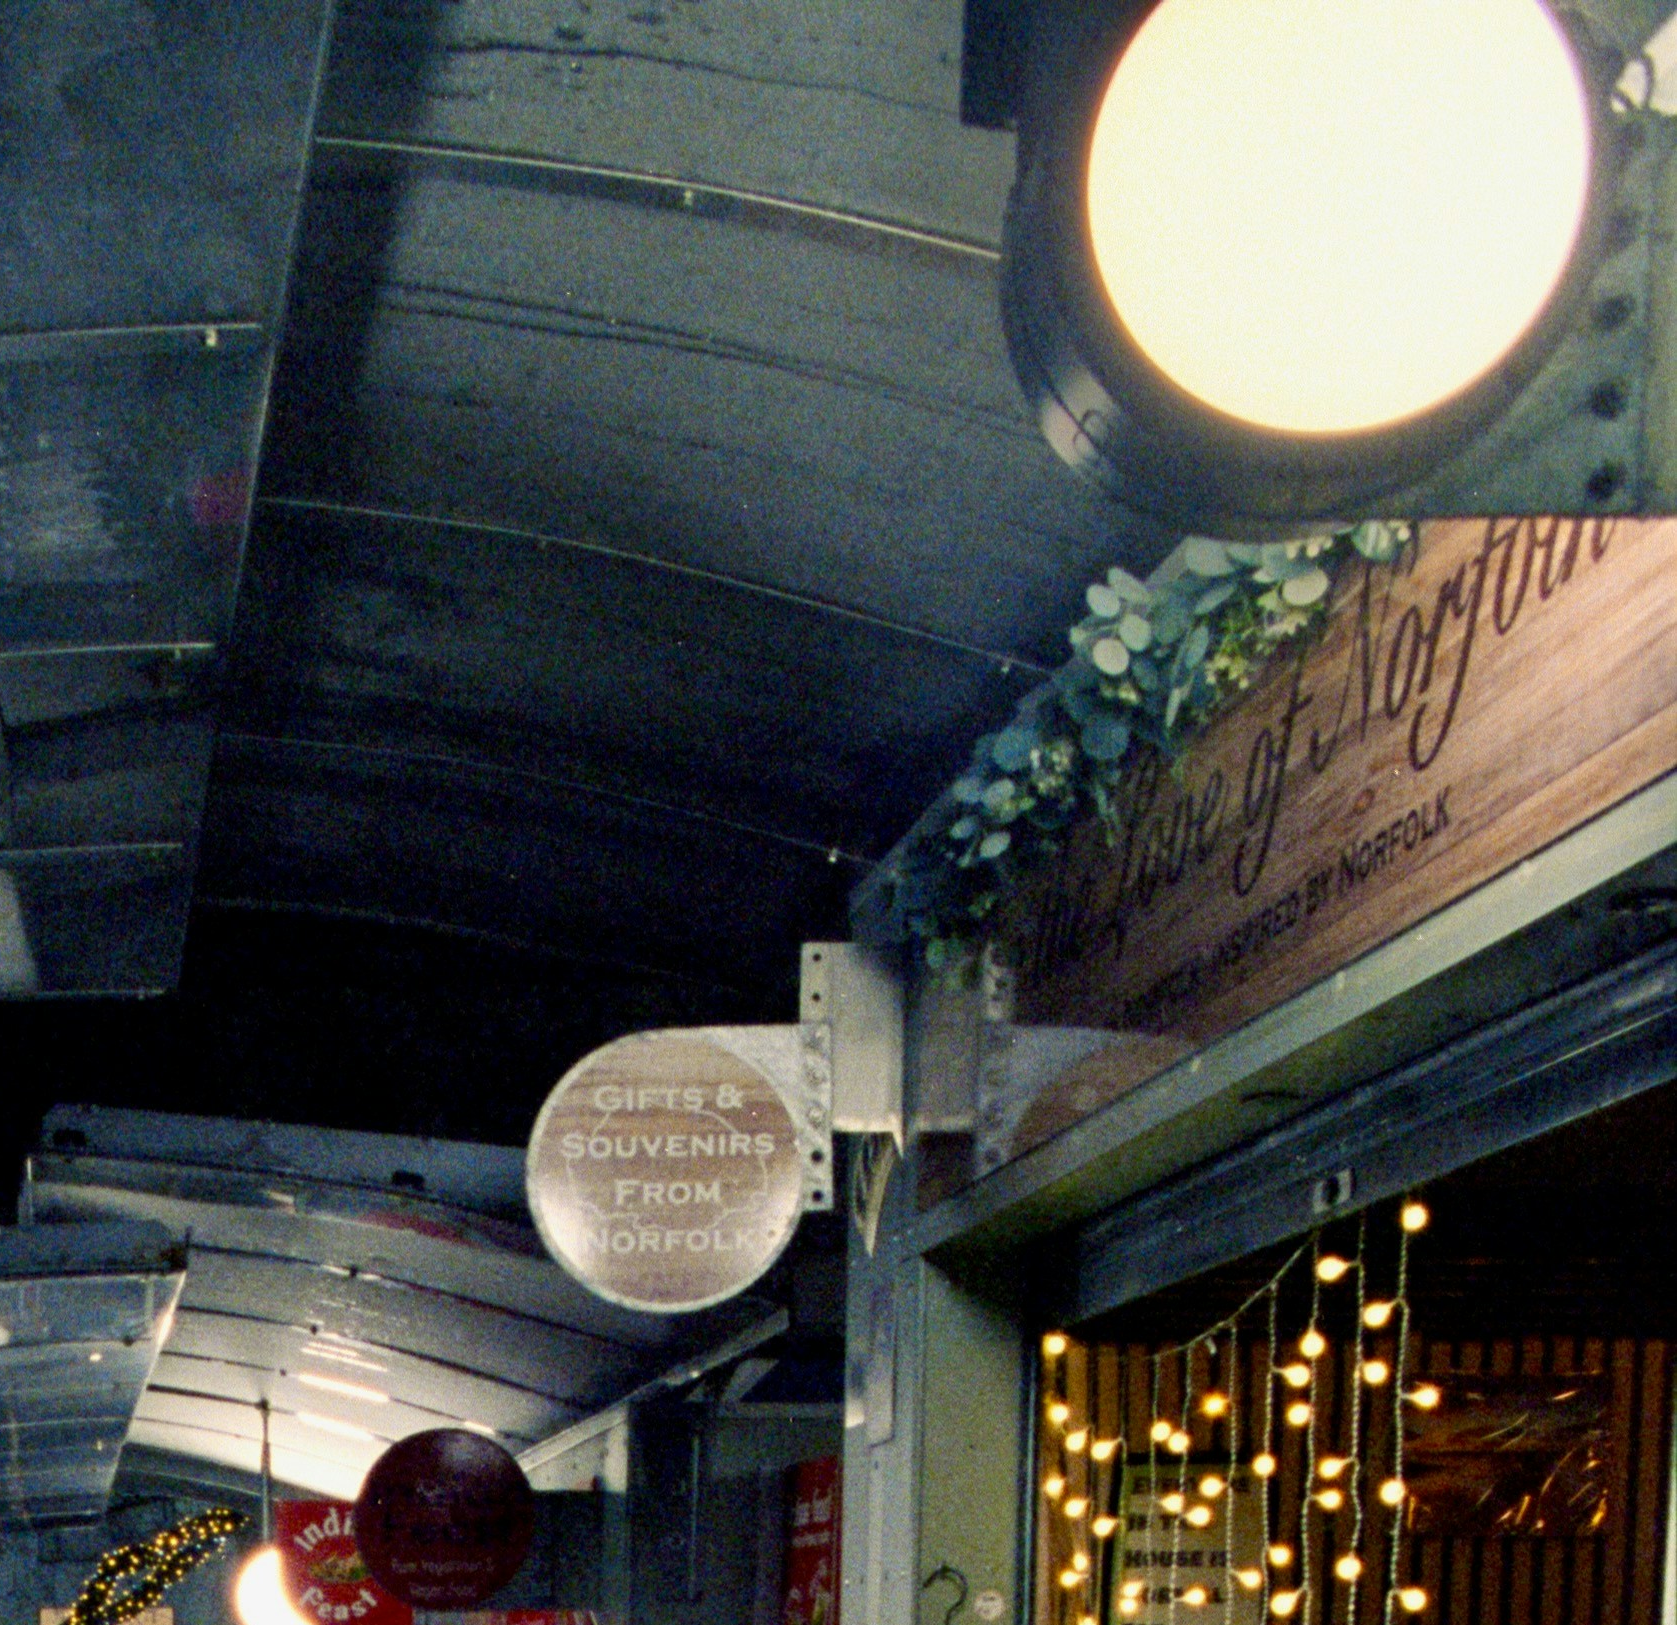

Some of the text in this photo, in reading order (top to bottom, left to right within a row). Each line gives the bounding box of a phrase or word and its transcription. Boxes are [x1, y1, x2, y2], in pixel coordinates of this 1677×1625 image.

[1232, 645, 1313, 896] of
[1306, 866, 1334, 916] BY
[1338, 786, 1451, 894] NORFOLK
[594, 1082, 744, 1113] GIFTS &
[561, 1132, 776, 1160] SOUVENIRS
[615, 1179, 722, 1206] FROM
[587, 1227, 755, 1255] NORFOLK
[1124, 1549, 1203, 1568] HOUSE
[301, 1586, 379, 1621] Feast
